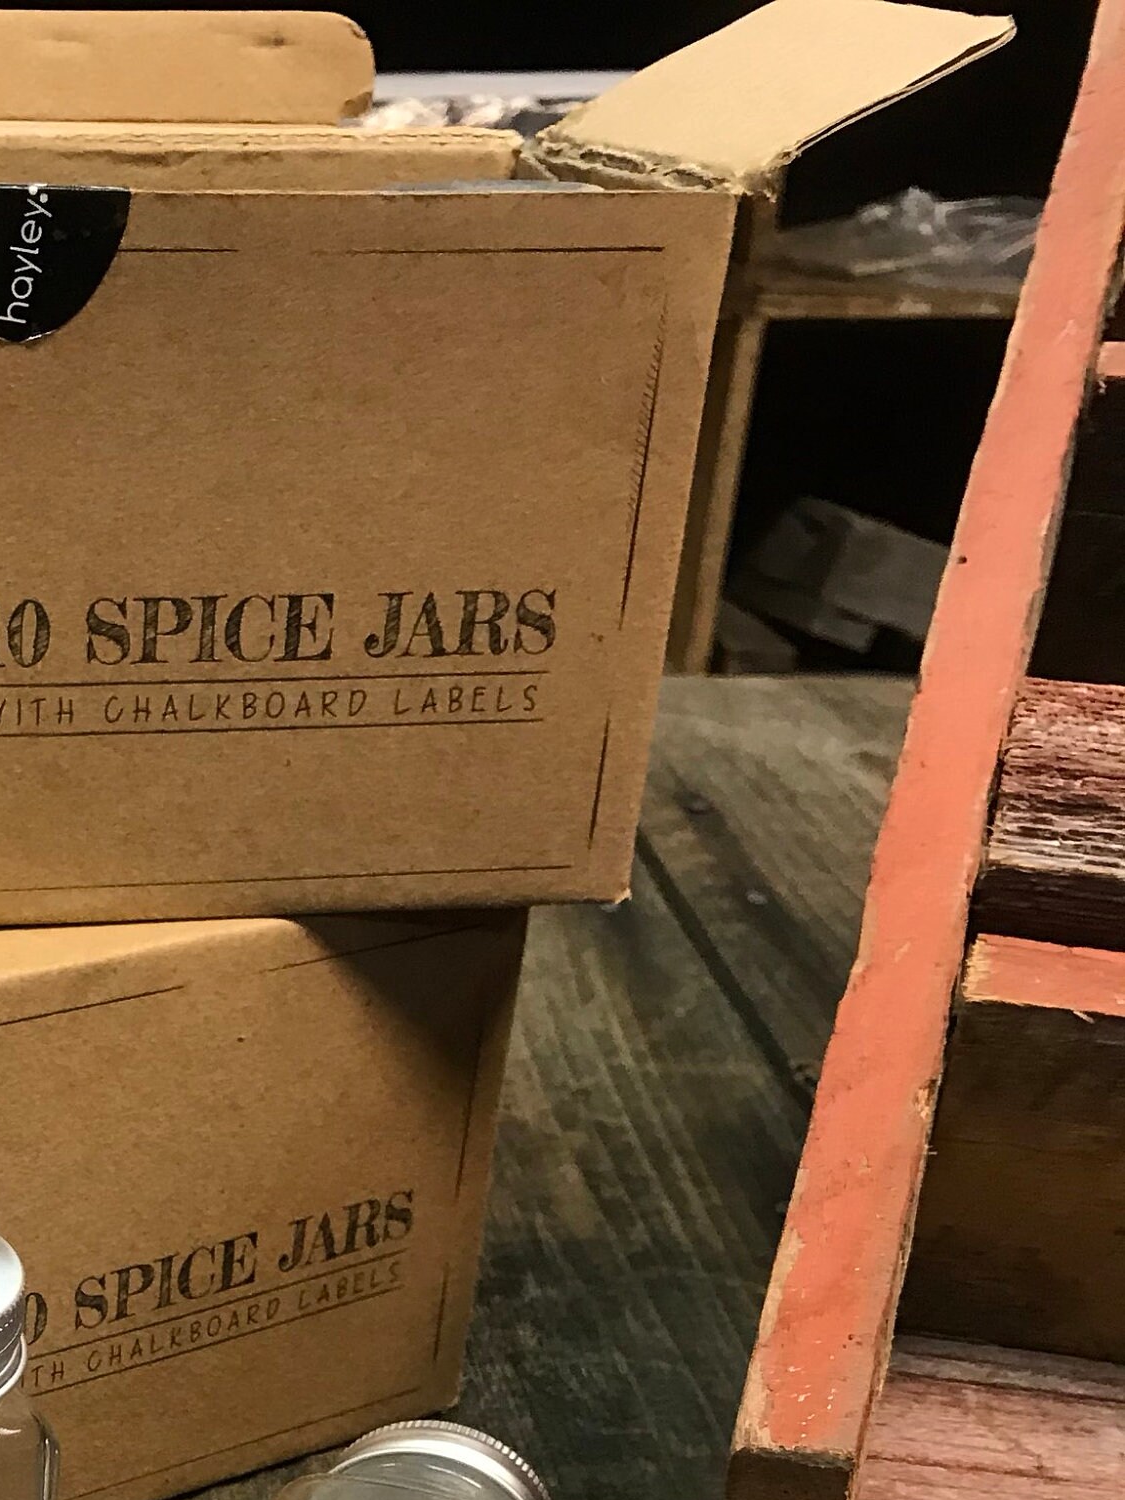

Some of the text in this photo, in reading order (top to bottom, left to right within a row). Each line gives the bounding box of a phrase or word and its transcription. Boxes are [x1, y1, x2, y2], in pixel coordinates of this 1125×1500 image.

[85, 593, 336, 666] SPICE
[363, 588, 558, 658] JARS
[104, 689, 368, 722] CHALKBOARD
[394, 684, 540, 716] LABELS
[22, 1188, 415, 1346] 0 SPICE JARS
[20, 1259, 402, 1389] ITH CHALKBOARD LABELS
